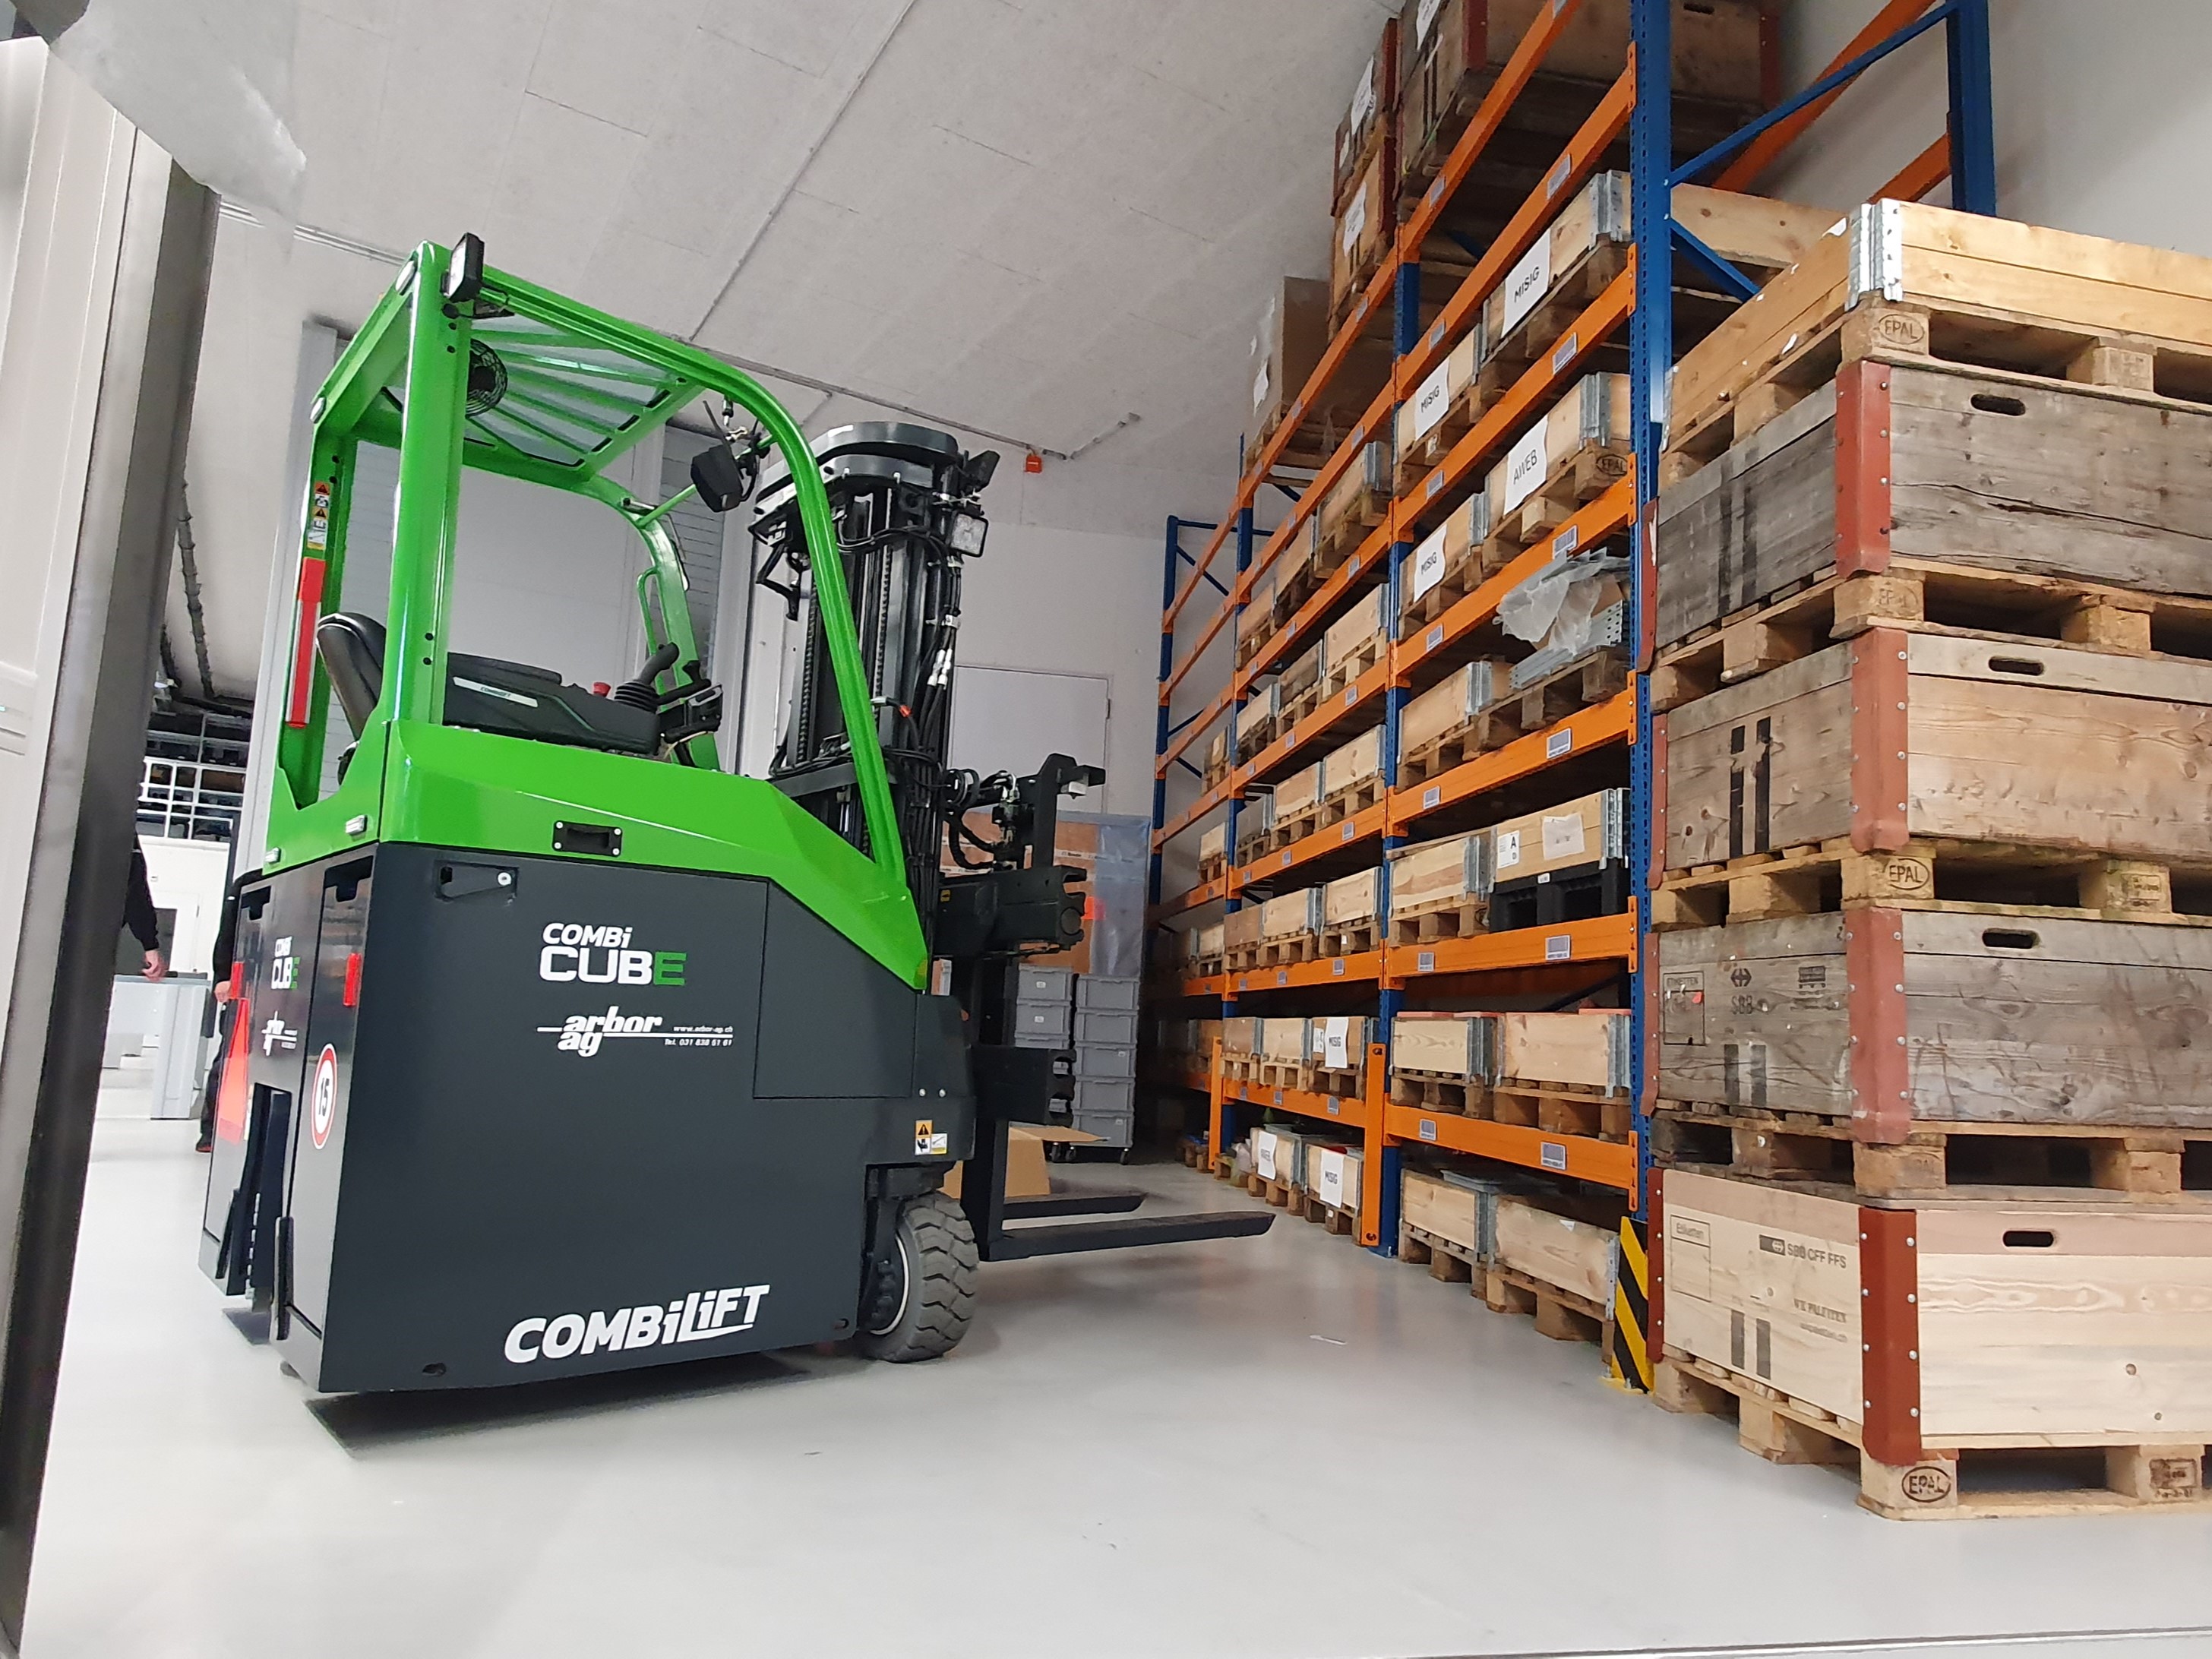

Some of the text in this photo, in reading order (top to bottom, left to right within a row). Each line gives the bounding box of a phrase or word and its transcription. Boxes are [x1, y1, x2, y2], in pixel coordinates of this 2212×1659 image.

[1514, 266, 1540, 303] MISIG
[1884, 319, 1918, 340] EPAL
[1512, 449, 1538, 485] AWEB
[1888, 864, 1923, 884] EPAL
[539, 945, 687, 986] CUBE
[1732, 994, 1753, 1015] SBB
[562, 1006, 663, 1033] arbor
[558, 1032, 603, 1057] ag
[318, 1077, 330, 1117] 15
[1808, 1248, 1826, 1262] CFF
[1828, 1252, 1847, 1269] FFS
[1907, 1474, 1945, 1495] EPAL
